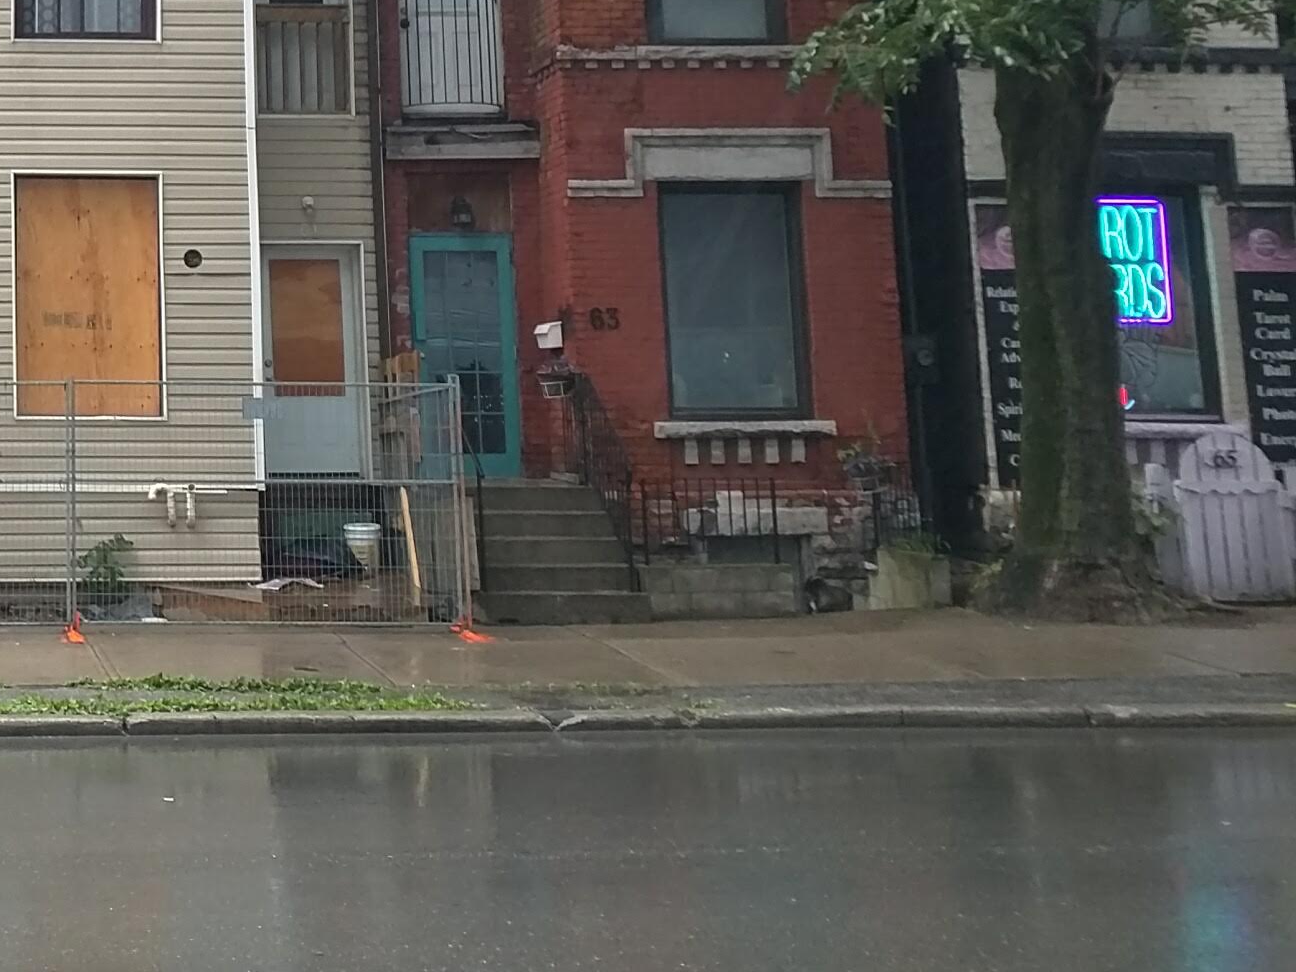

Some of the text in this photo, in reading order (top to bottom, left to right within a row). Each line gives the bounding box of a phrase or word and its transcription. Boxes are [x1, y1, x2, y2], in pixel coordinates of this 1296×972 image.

[1100, 205, 1157, 262] ROT
[590, 307, 620, 331] 63
[1109, 262, 1166, 319] RDS
